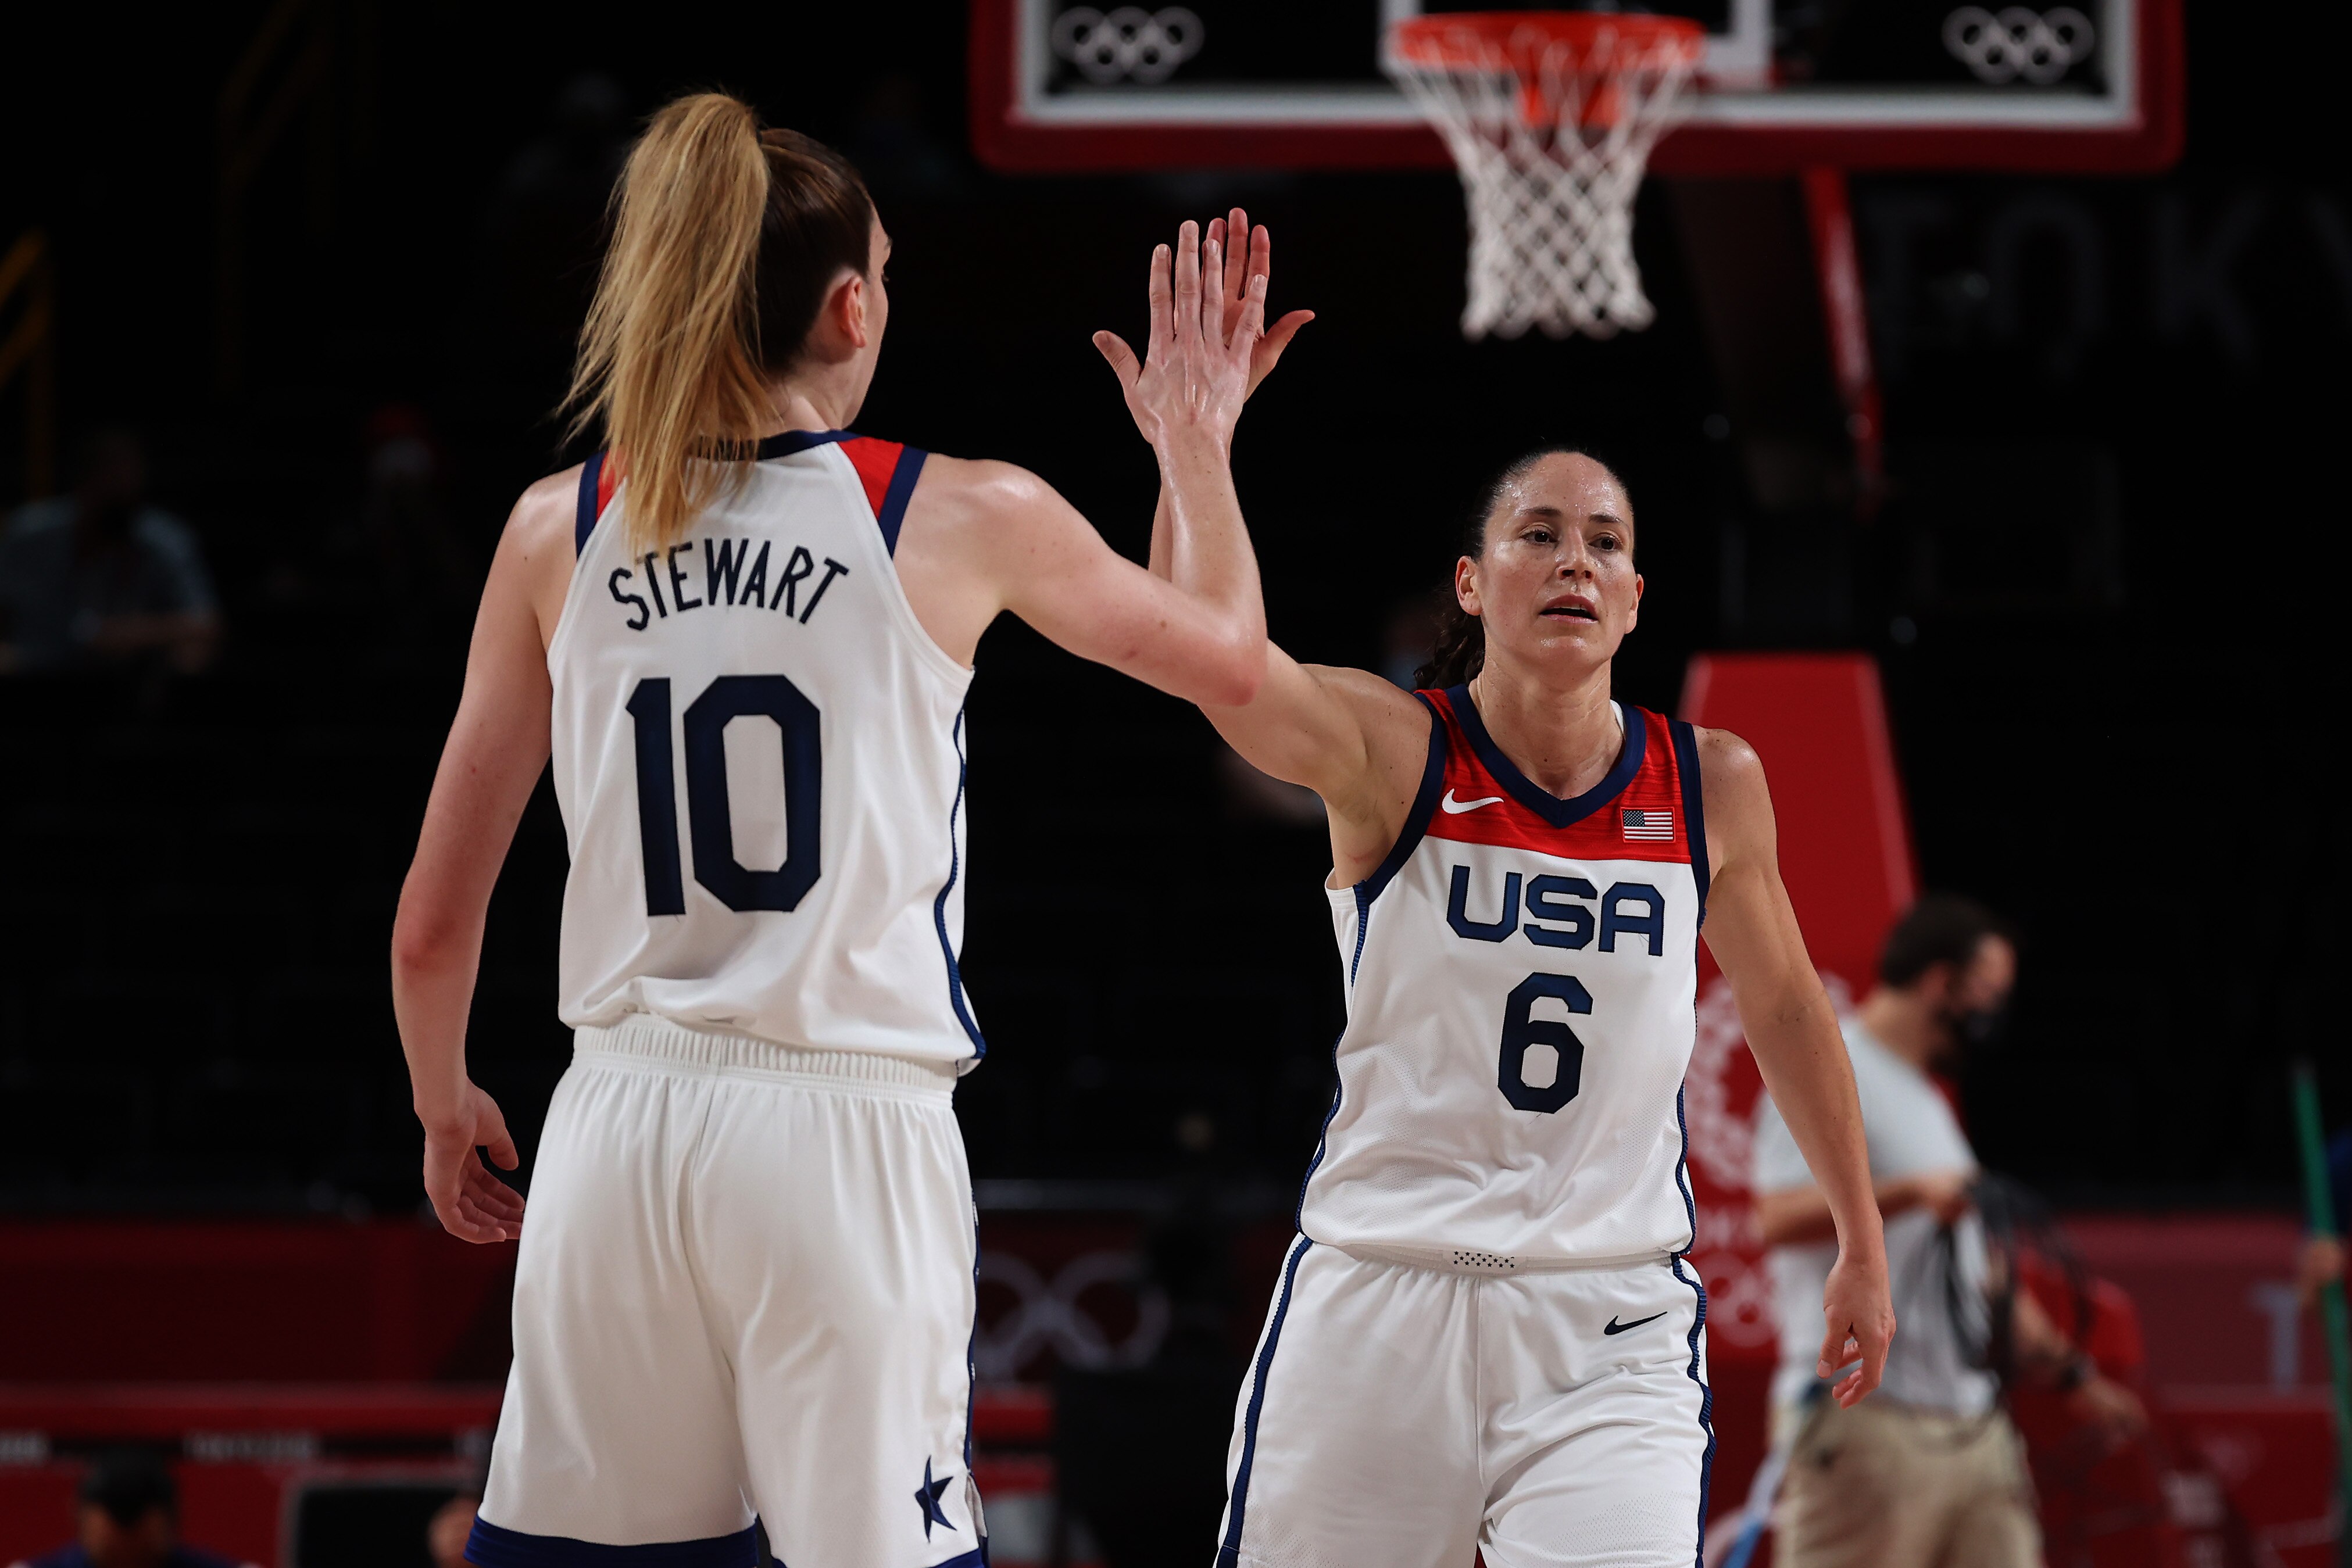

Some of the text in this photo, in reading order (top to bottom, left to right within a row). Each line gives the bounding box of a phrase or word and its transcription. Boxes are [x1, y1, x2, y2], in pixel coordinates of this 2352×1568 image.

[608, 538, 849, 632] STEWART
[625, 674, 823, 917] 10
[1446, 865, 1665, 957] USA
[1497, 971, 1594, 1115] 6
